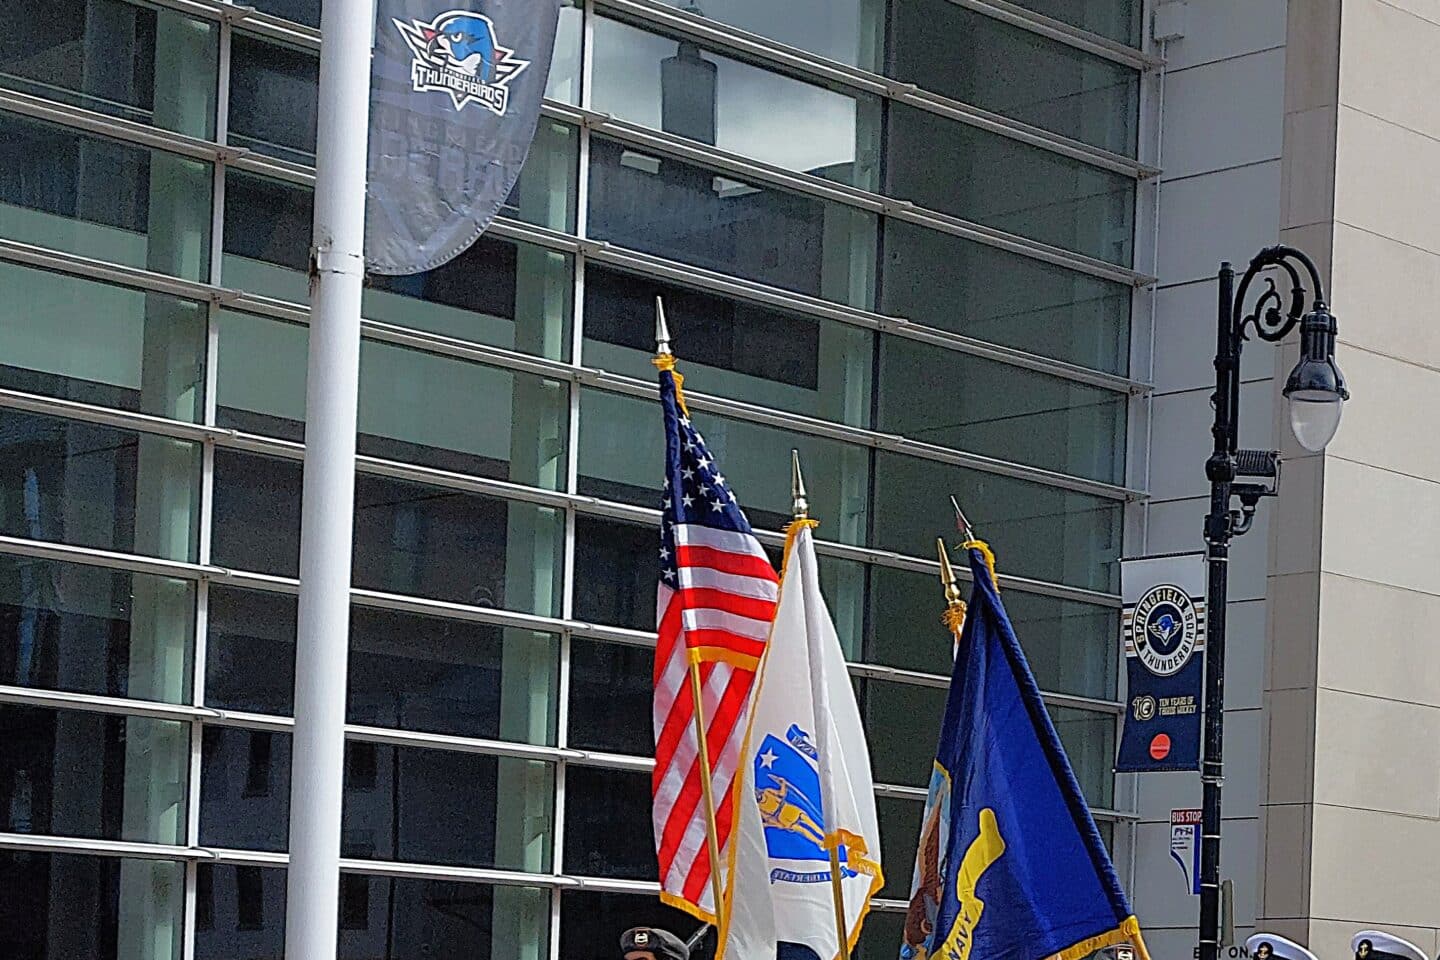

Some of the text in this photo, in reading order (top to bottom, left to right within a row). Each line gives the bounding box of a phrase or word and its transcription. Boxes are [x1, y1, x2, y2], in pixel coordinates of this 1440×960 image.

[417, 65, 503, 109] THUNDERBIRDS
[1136, 589, 1186, 644] SPRINGFIELD
[1143, 612, 1195, 672] THUNDERBIRDS
[1172, 811, 1202, 822] BUS STOP
